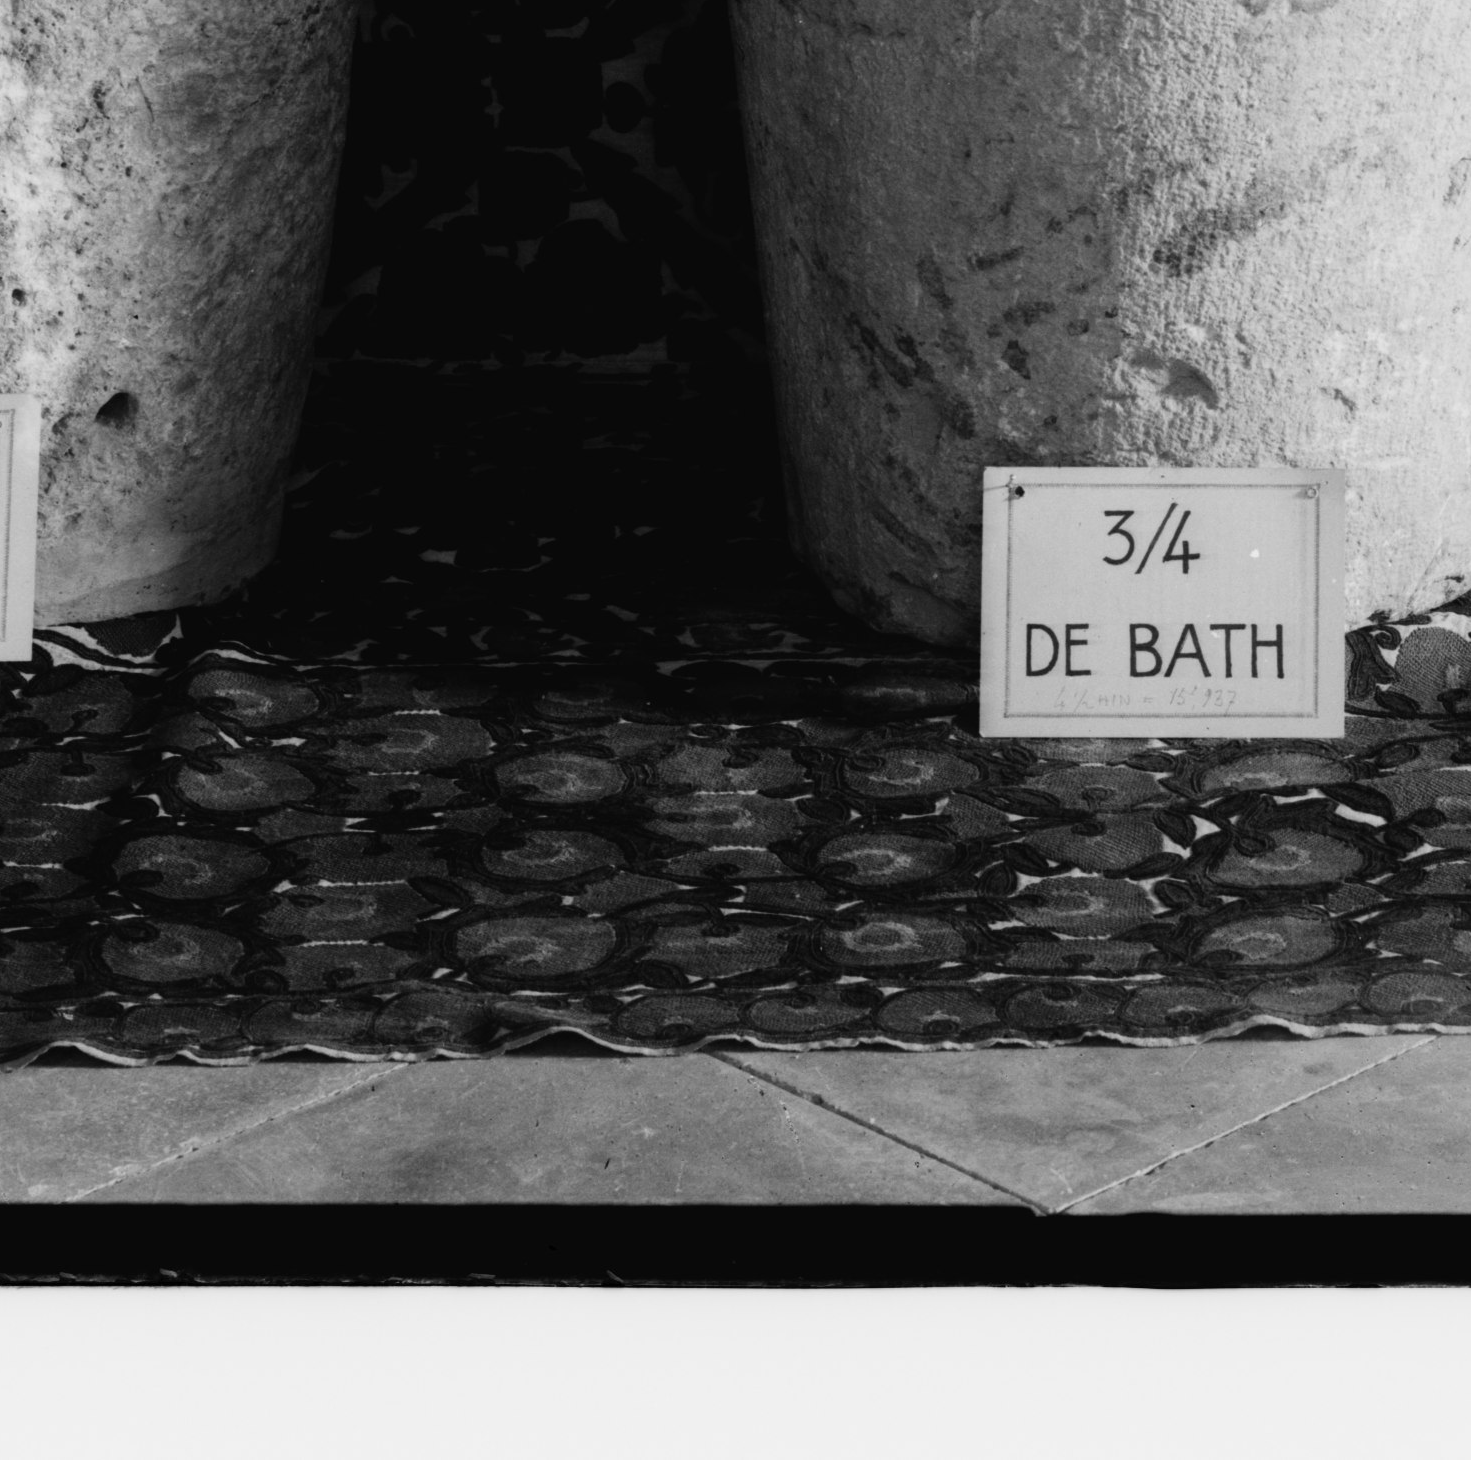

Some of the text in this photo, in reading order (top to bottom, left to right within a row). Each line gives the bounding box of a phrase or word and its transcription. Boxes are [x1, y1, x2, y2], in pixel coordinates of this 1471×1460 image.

[1103, 503, 1200, 574] 3/4
[1026, 624, 1284, 679] DE BATH
